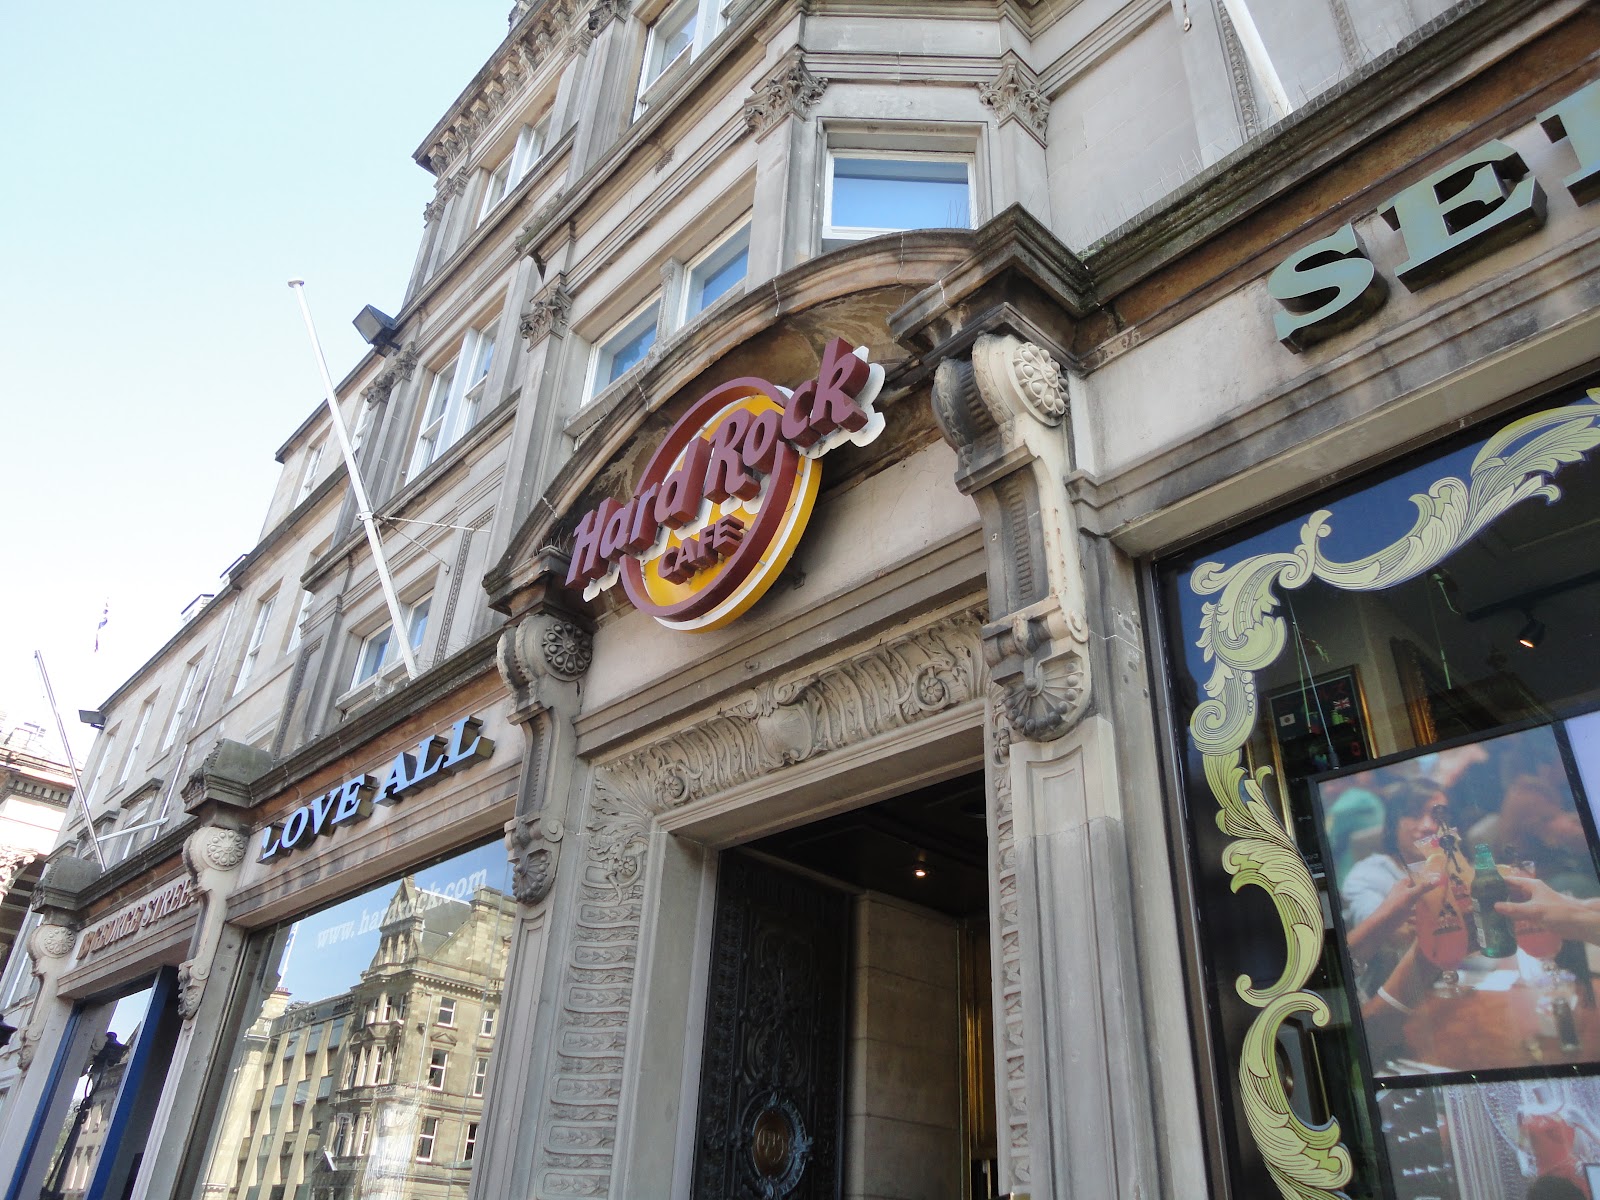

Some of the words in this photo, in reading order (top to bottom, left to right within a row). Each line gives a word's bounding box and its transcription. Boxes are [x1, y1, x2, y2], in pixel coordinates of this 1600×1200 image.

[565, 437, 710, 590] Hard
[704, 337, 870, 502] Rock
[658, 514, 746, 585] CAFE
[260, 774, 373, 862] LOVE
[374, 716, 490, 806] ALL
